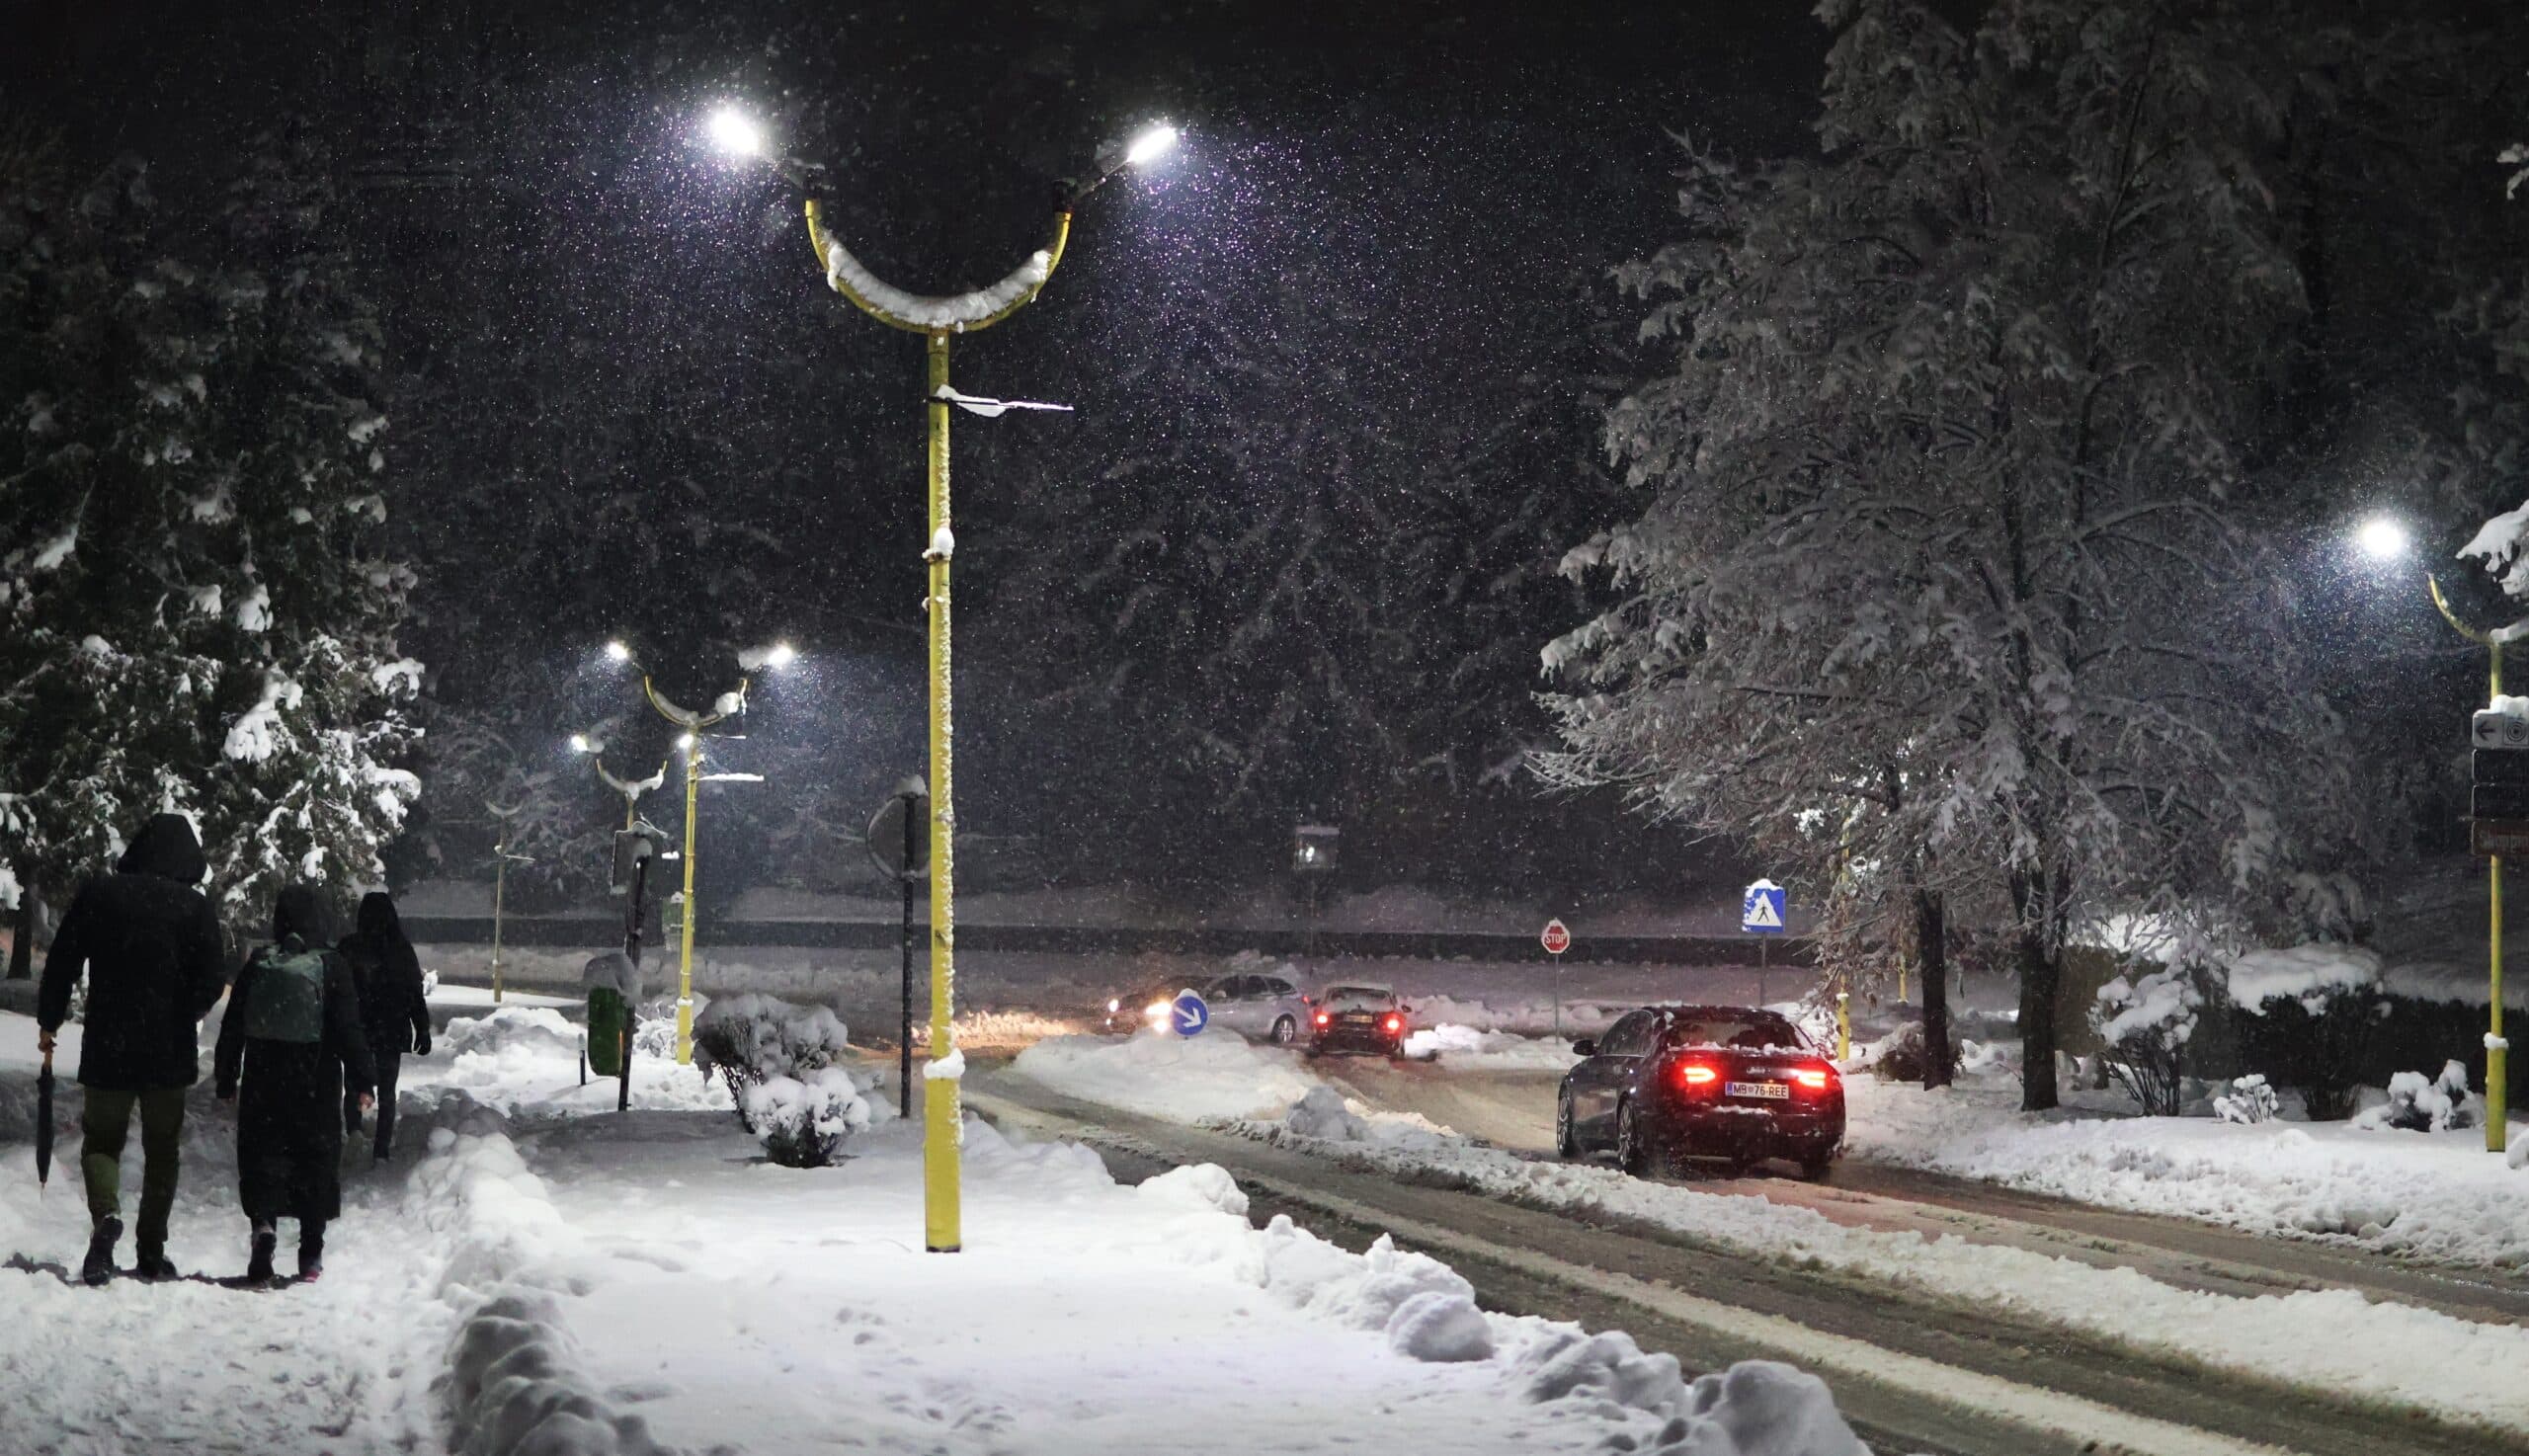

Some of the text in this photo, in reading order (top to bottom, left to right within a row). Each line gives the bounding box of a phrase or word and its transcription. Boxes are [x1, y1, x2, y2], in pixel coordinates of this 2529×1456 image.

[1545, 933, 1567, 944] STOP
[1733, 1084, 1787, 1097] MB 76-REE
